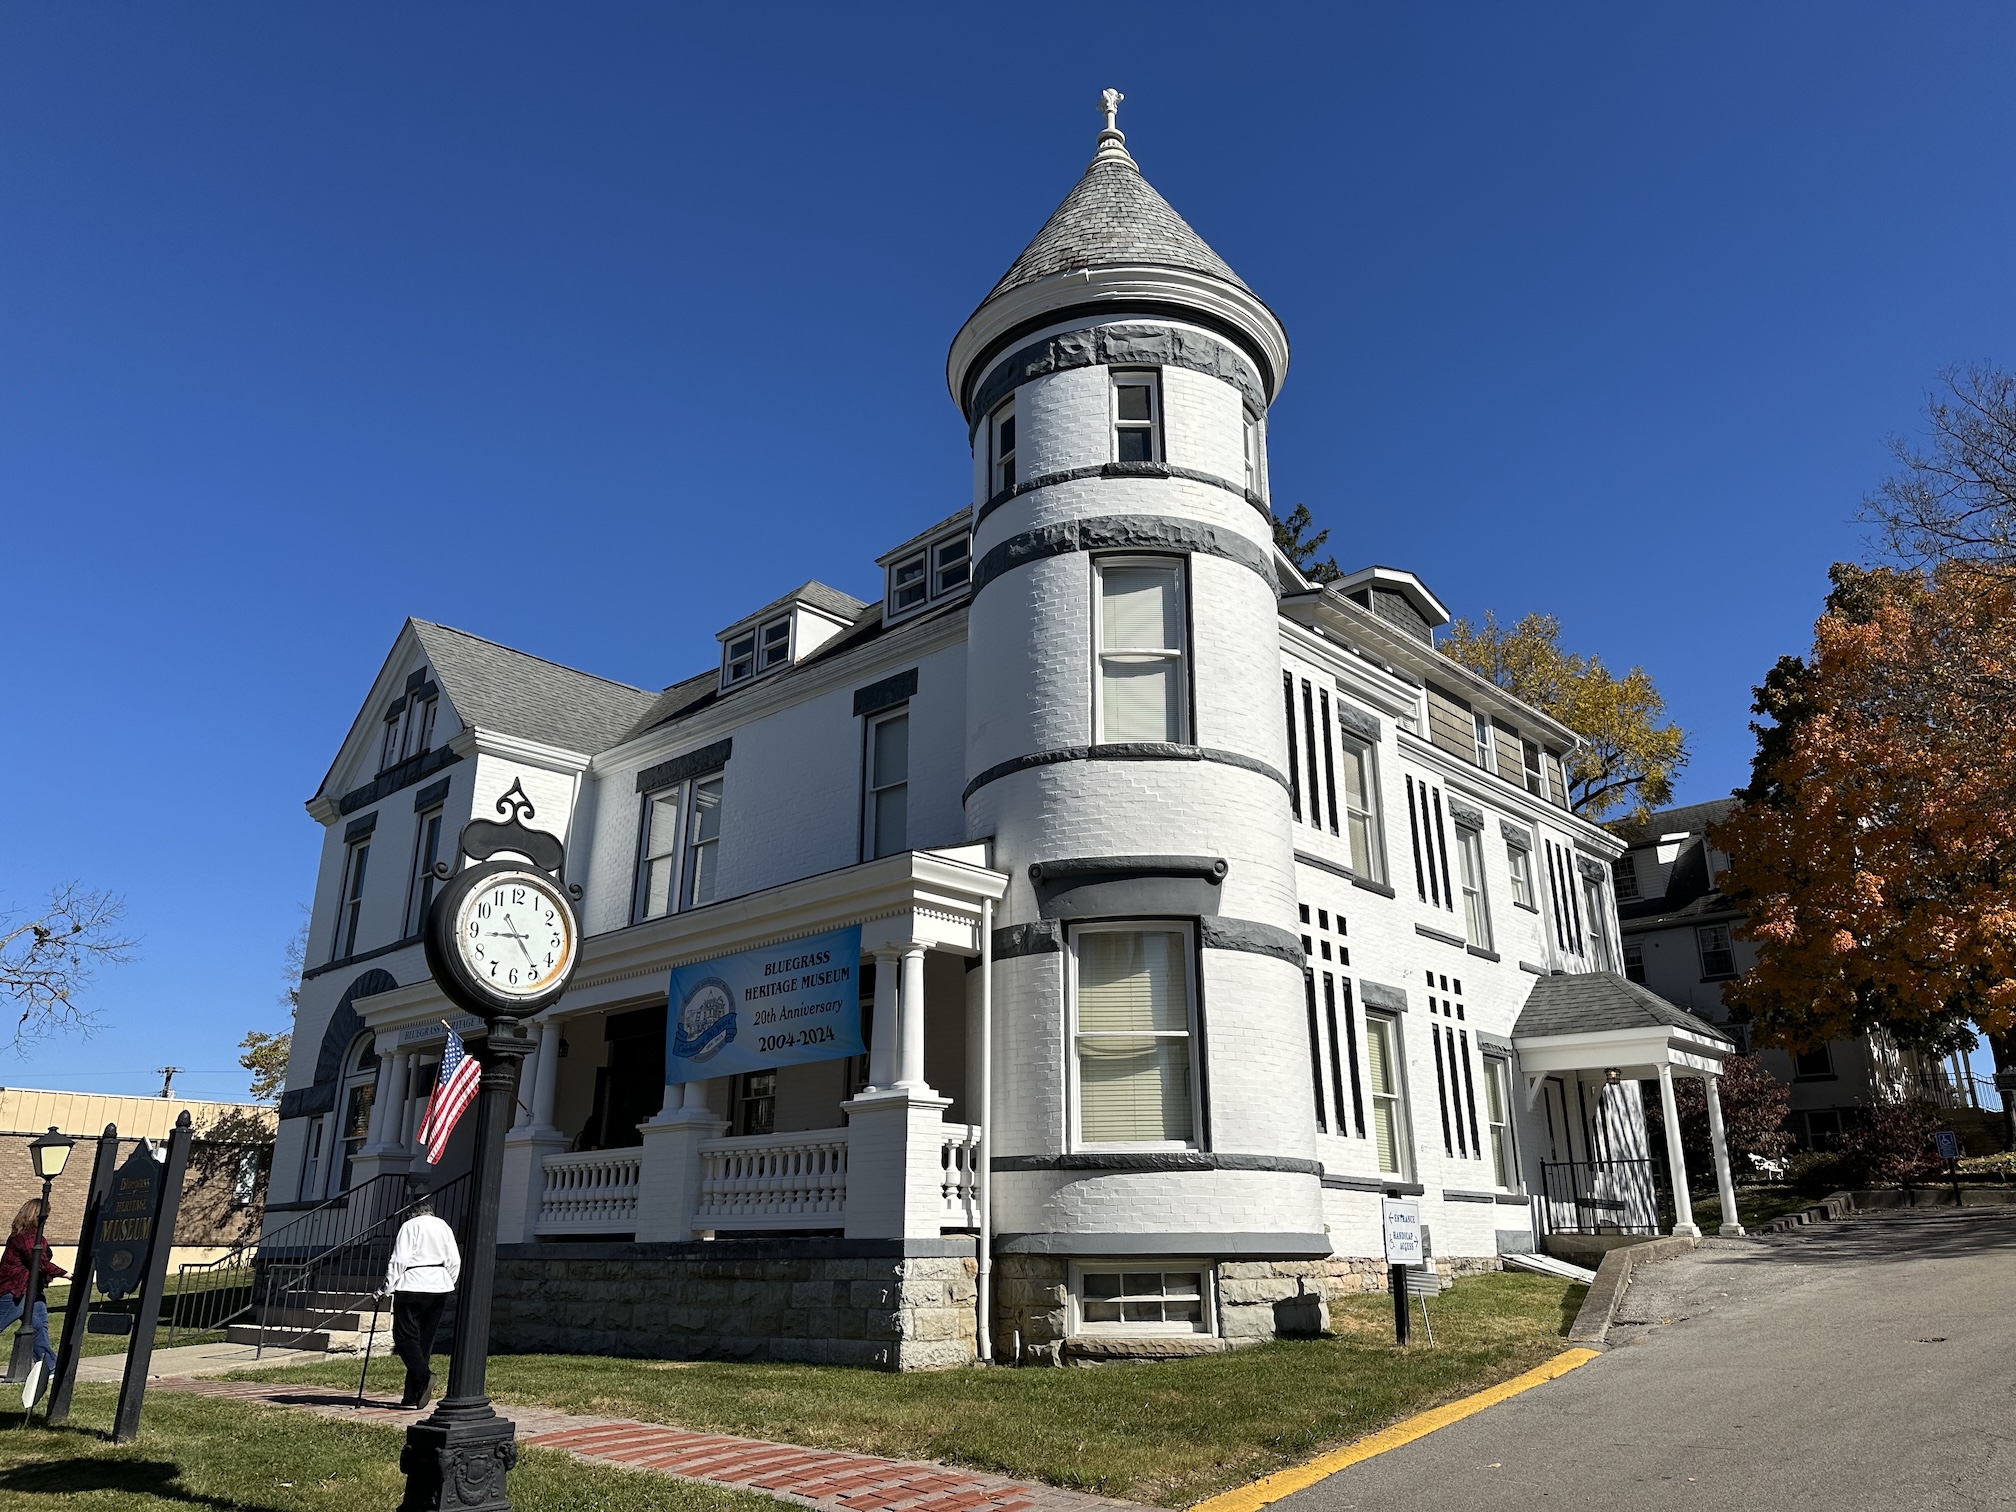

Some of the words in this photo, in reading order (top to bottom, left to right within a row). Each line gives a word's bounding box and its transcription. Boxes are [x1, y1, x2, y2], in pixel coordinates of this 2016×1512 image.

[494, 890, 504, 907] 11
[512, 888, 525, 905] 12
[534, 895, 539, 911] 1
[478, 902, 491, 919] 10
[545, 910, 554, 927] 2
[469, 921, 479, 938] 9
[550, 931, 560, 948] 3
[474, 943, 485, 961] 8
[543, 951, 554, 967] 4
[489, 960, 500, 977] 7
[764, 950, 830, 976] BLUEGRASS
[509, 967, 518, 985] 6
[528, 964, 538, 981] 5
[745, 978, 798, 1001] HERITAGE
[801, 966, 850, 990] MUSEUM
[753, 1007, 776, 1026] 20th
[779, 999, 843, 1022] Anniversary
[404, 1024, 441, 1040] BLUEGRASS
[442, 1016, 476, 1033] HRITAGE
[758, 1024, 836, 1053] 2004-2024
[116, 1199, 147, 1213] HERITAGE
[1394, 1214, 1415, 1223] ENTRANCE
[99, 1217, 152, 1242] MUSEUM
[1393, 1231, 1413, 1240] HANDICAP
